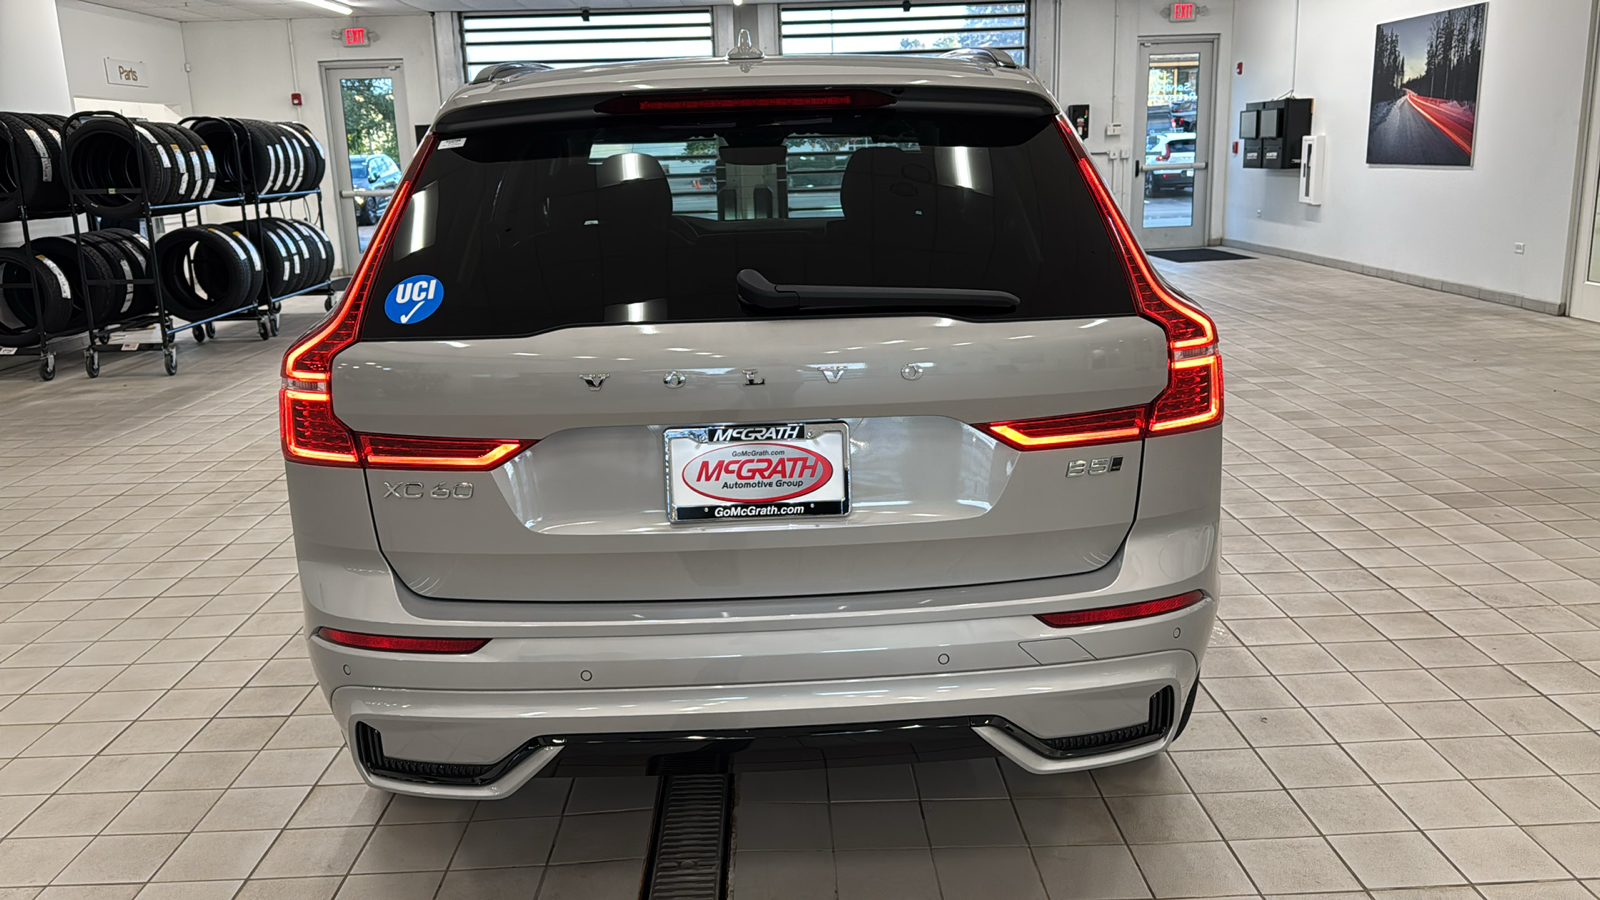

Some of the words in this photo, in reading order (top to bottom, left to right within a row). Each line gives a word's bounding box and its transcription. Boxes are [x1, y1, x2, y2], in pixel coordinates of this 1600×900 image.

[1174, 3, 1193, 19] EXIT
[345, 28, 365, 44] EXIT
[118, 65, 138, 82] Parts
[395, 279, 437, 304] UCI
[579, 362, 925, 392] VOLVO
[731, 449, 785, 458] GoMcGrath.com
[1065, 459, 1109, 478] B5
[721, 480, 774, 490] Automotive
[775, 479, 804, 489] Group
[714, 505, 805, 518] GoMcGrath.com
